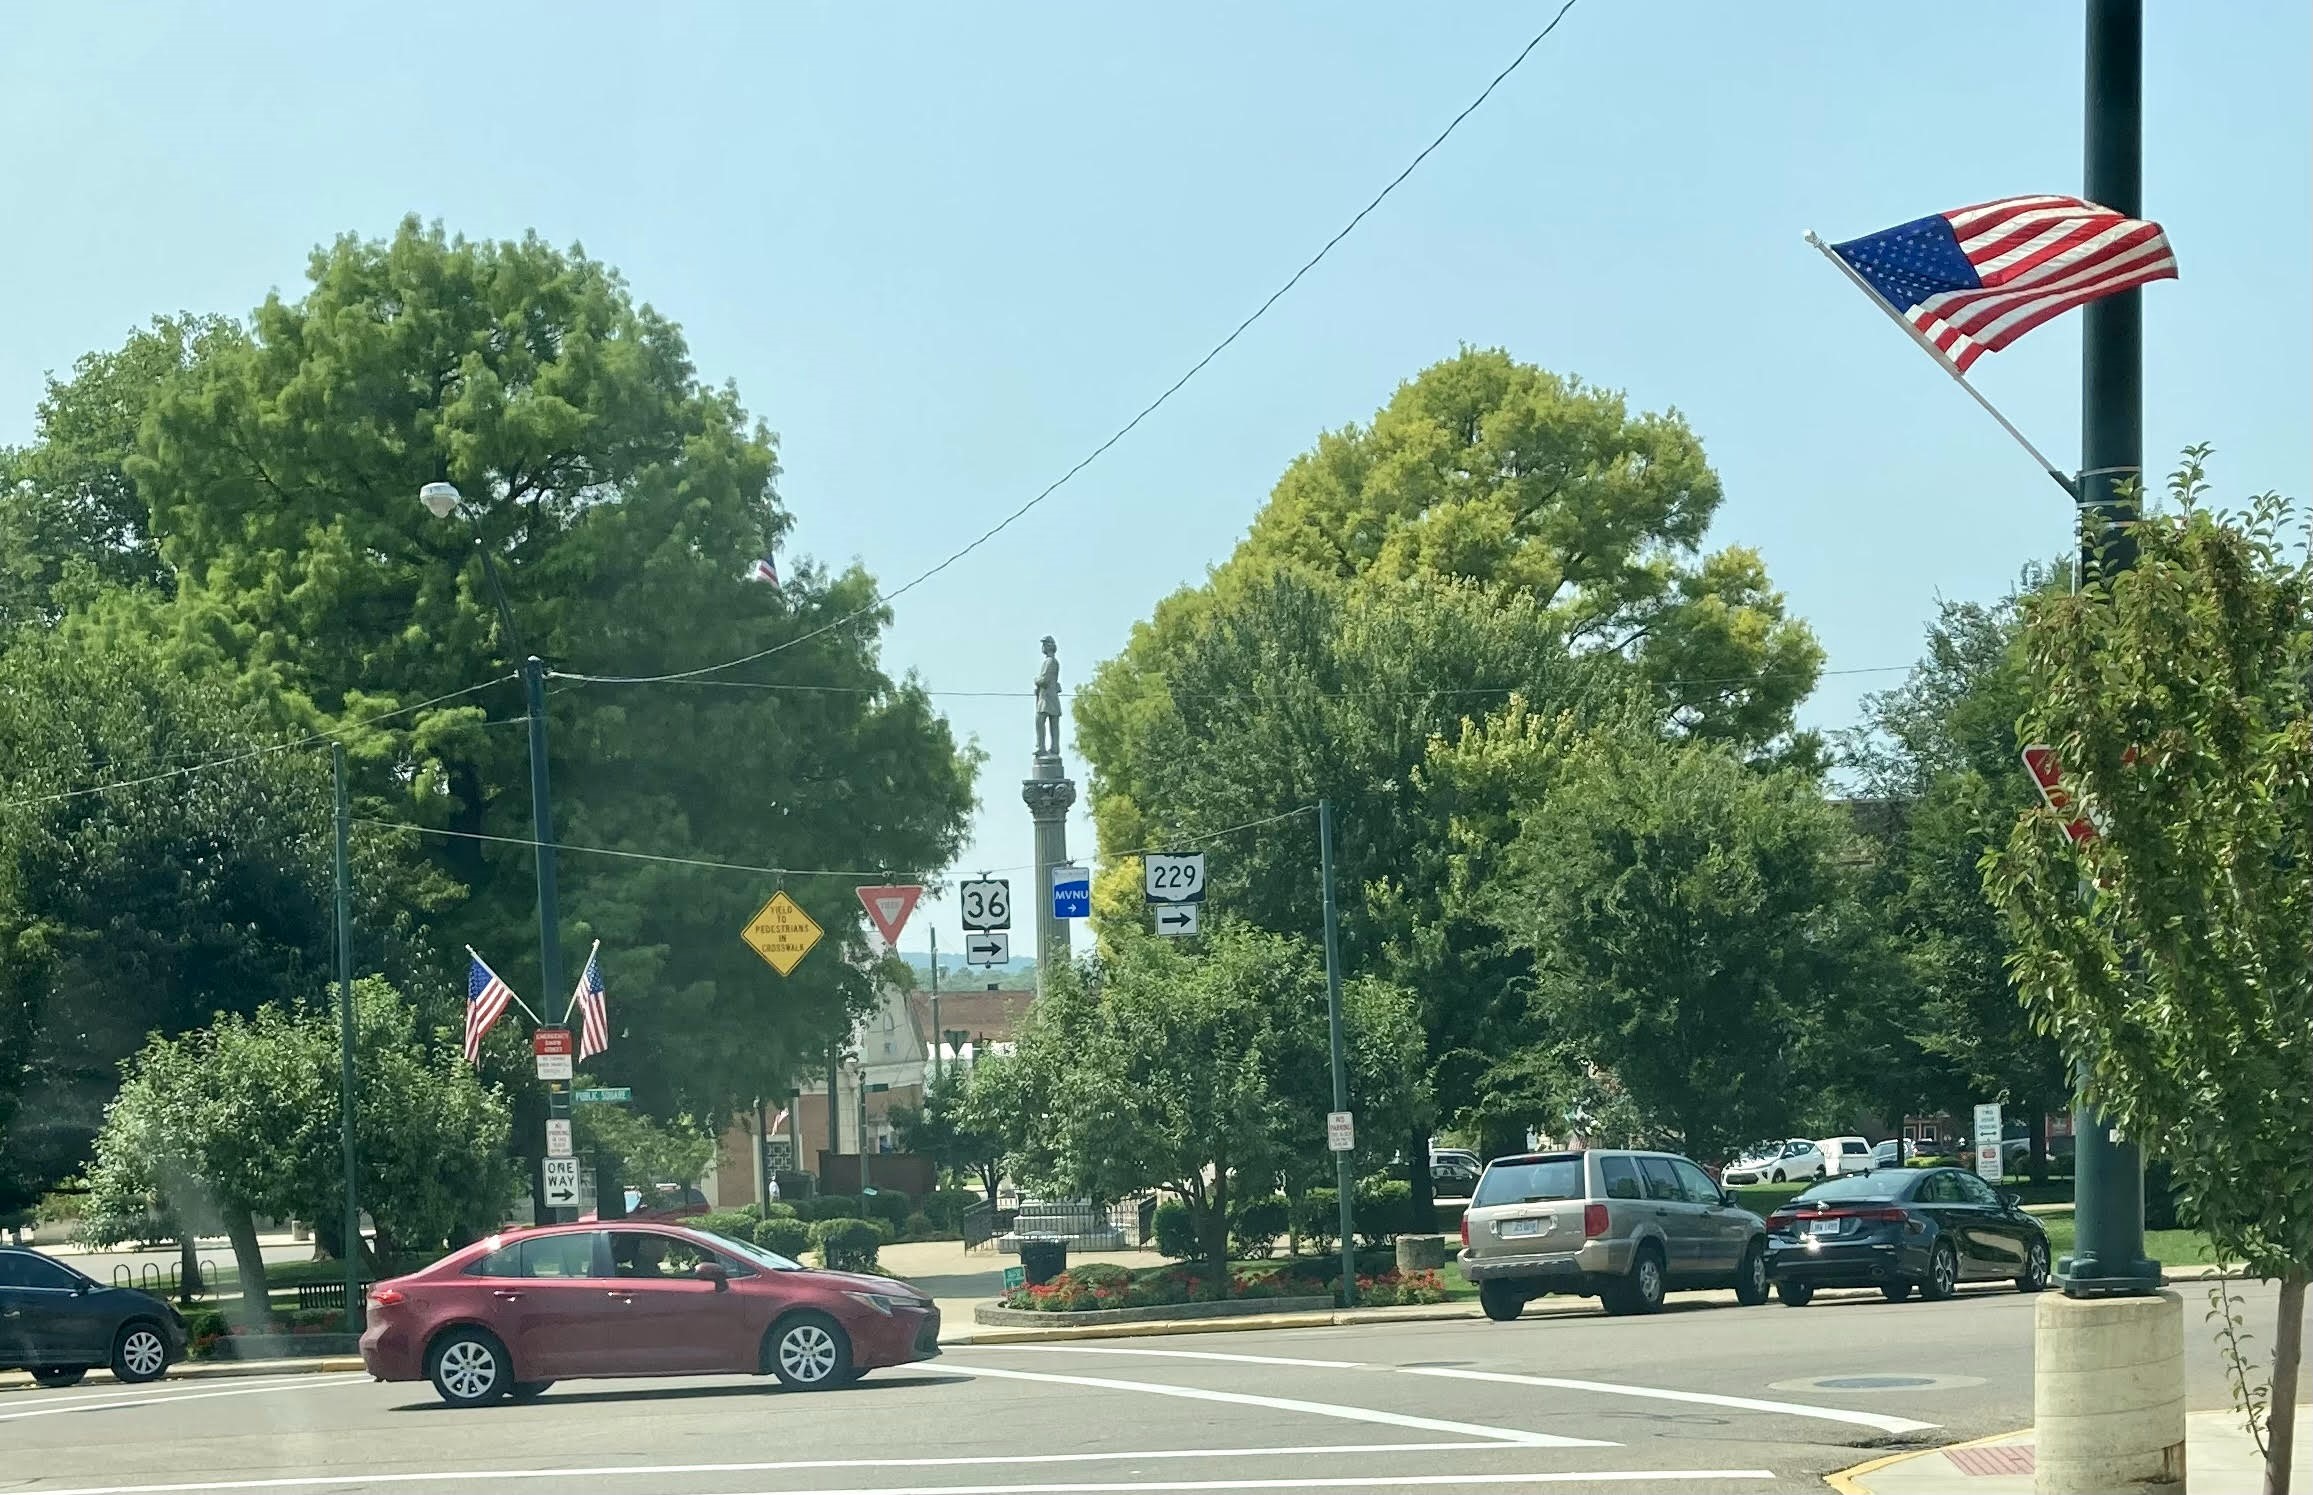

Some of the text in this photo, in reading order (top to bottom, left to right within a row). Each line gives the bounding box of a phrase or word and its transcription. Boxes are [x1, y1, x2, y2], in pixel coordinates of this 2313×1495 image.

[1154, 865, 1196, 888] 229
[1055, 890, 1089, 900] MVNU
[968, 891, 1005, 918] 36
[770, 905, 793, 914] YIELD
[777, 915, 787, 923] TO
[755, 924, 809, 933] PEDESTRIANS
[778, 934, 787, 942] IN
[761, 943, 804, 952] CROSSWALK
[548, 1162, 574, 1173] ONE
[548, 1175, 574, 1186] WAY
